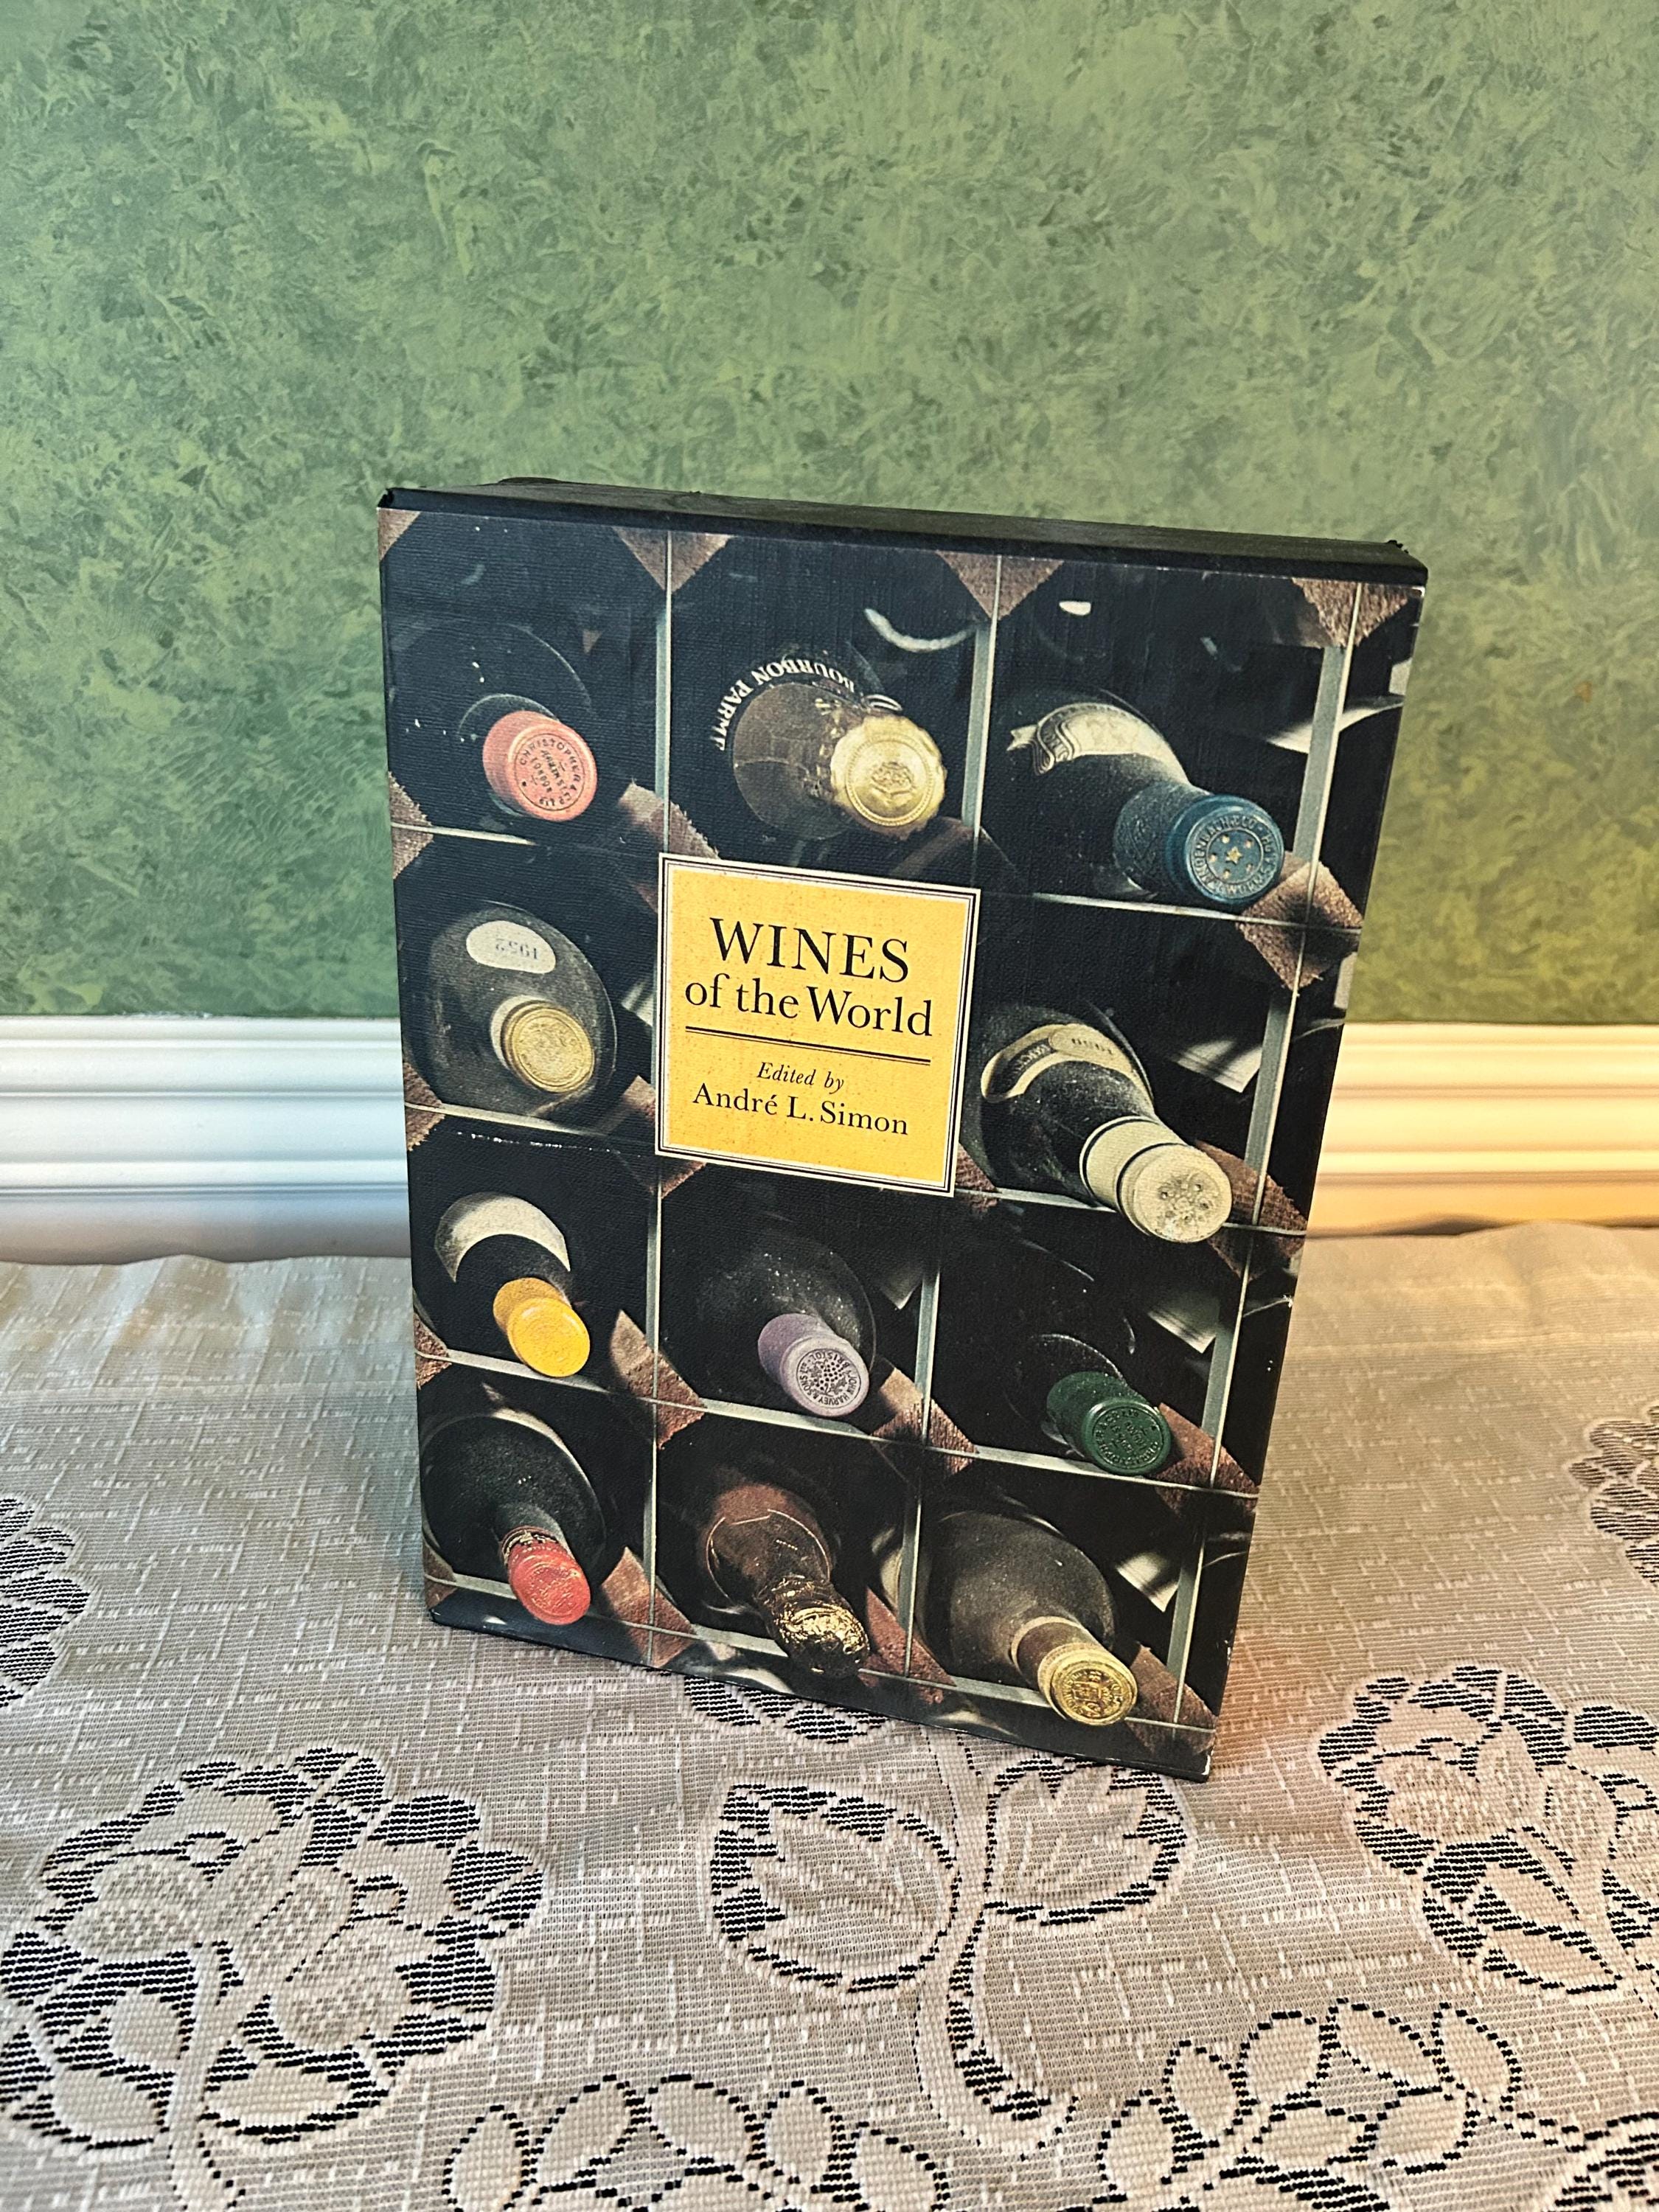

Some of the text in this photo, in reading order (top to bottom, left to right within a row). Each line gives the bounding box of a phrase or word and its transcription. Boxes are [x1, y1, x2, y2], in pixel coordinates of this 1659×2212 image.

[709, 917, 908, 983] WINES
[685, 973, 933, 1037] of the World
[756, 1061, 844, 1095] Edited by
[692, 1082, 908, 1135] André L. Simon
